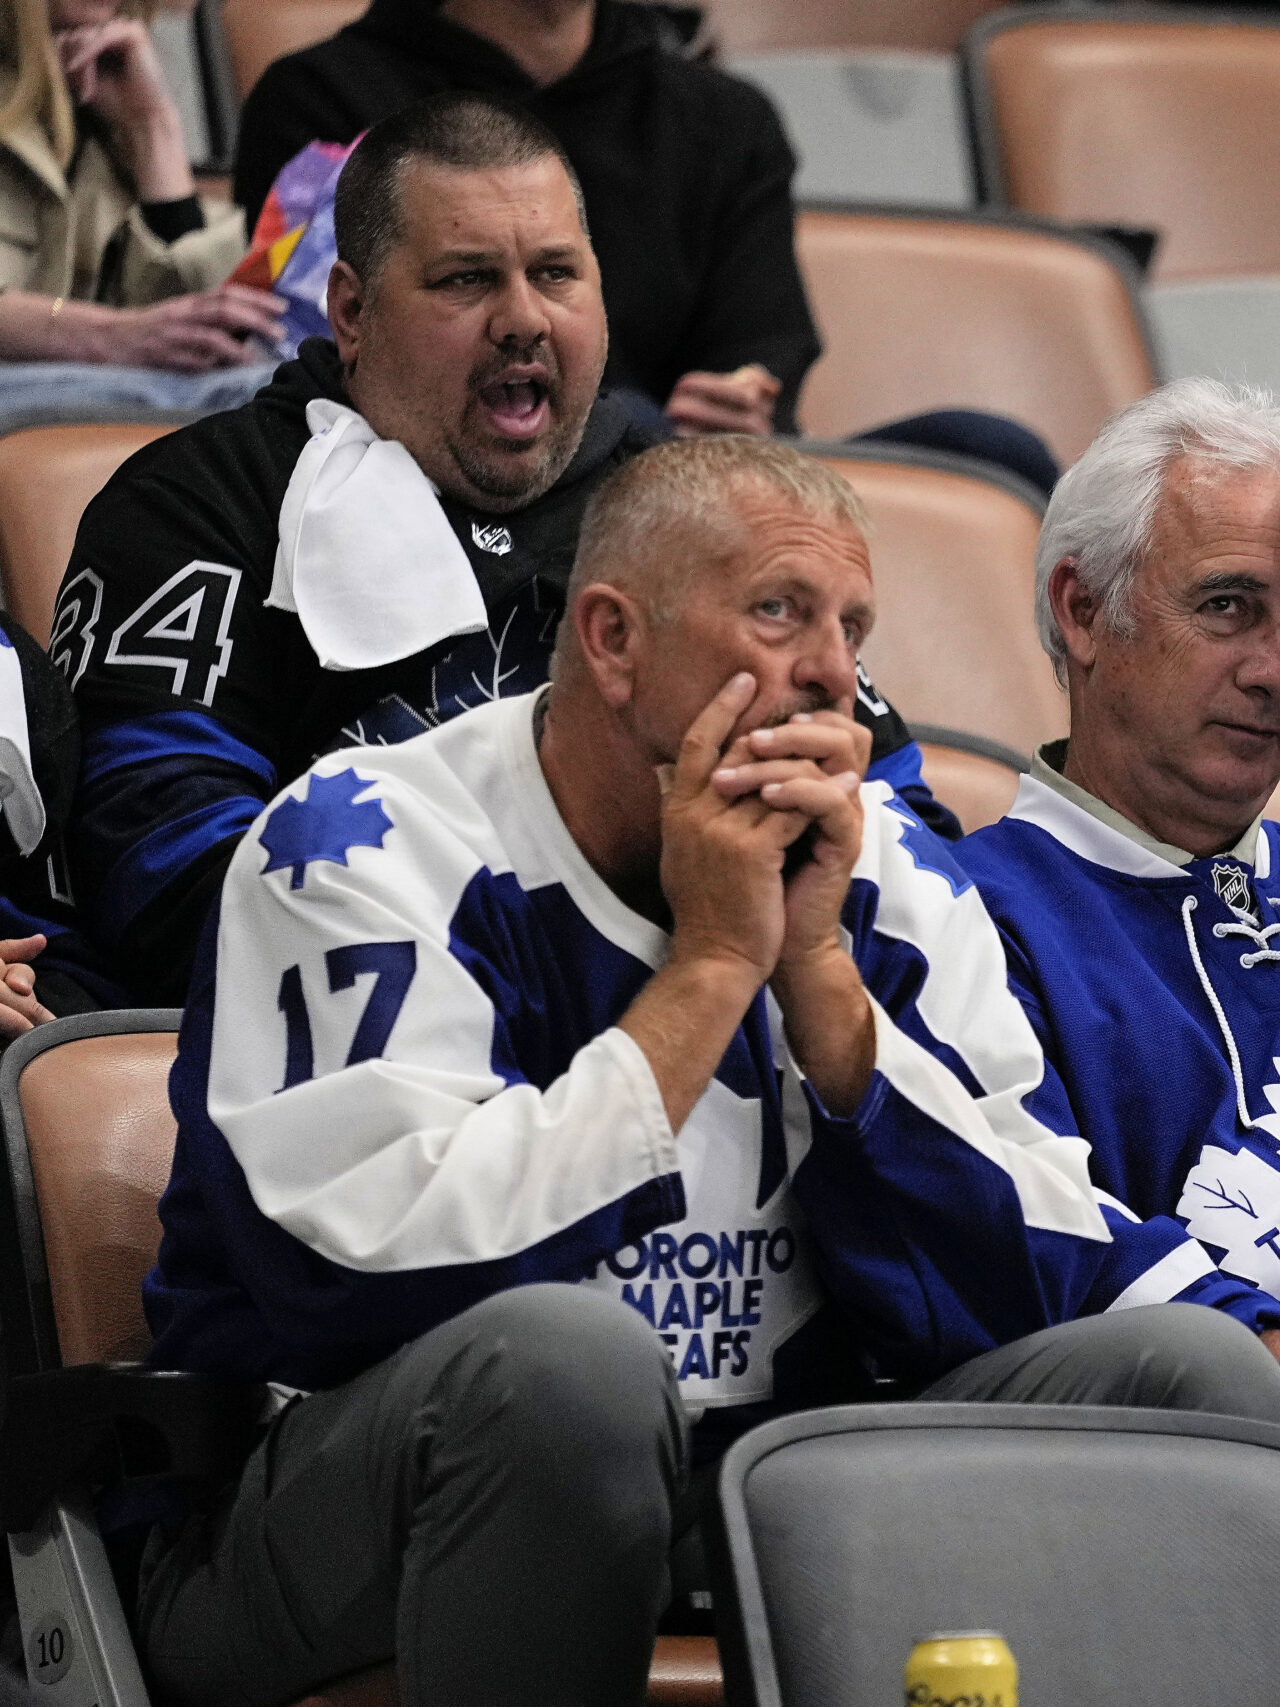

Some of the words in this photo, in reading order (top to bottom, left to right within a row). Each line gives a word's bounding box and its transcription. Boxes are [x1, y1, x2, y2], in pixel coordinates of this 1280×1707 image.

[1222, 878, 1242, 904] NHL
[272, 940, 418, 1096] 17
[585, 1226, 796, 1281] ORONTO
[37, 1627, 65, 1668] 10
